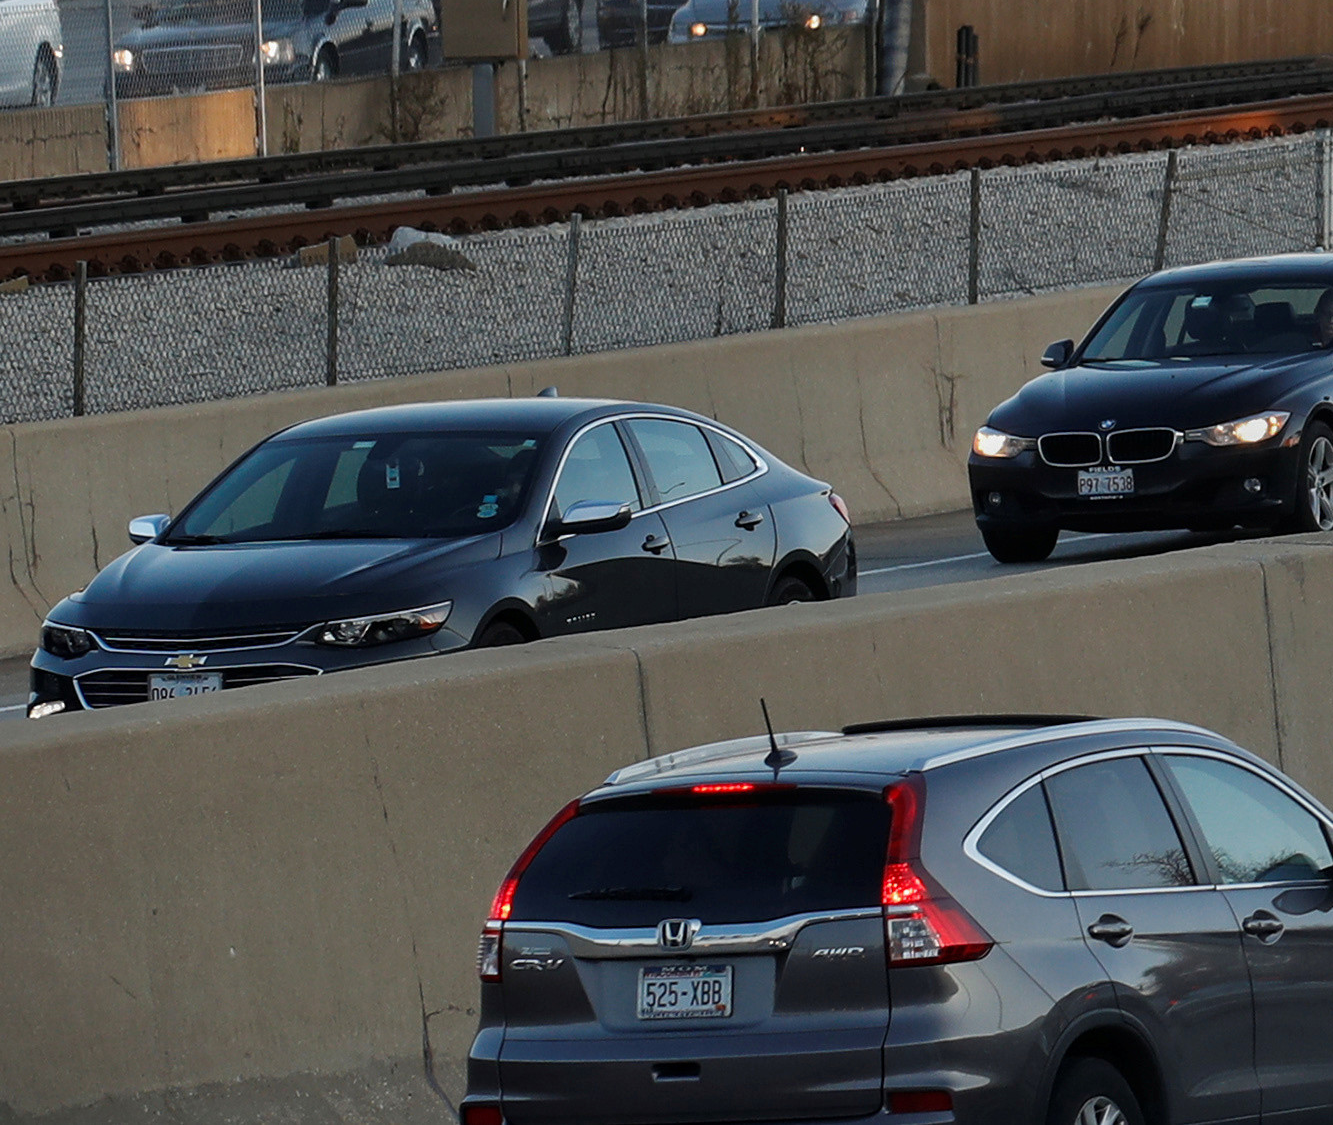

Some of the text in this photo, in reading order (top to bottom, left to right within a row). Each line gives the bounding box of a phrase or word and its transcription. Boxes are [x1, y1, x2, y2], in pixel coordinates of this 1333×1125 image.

[1080, 476, 1133, 493] P97 7538
[812, 946, 865, 958] AWD
[645, 979, 723, 1008] 525-XBB
